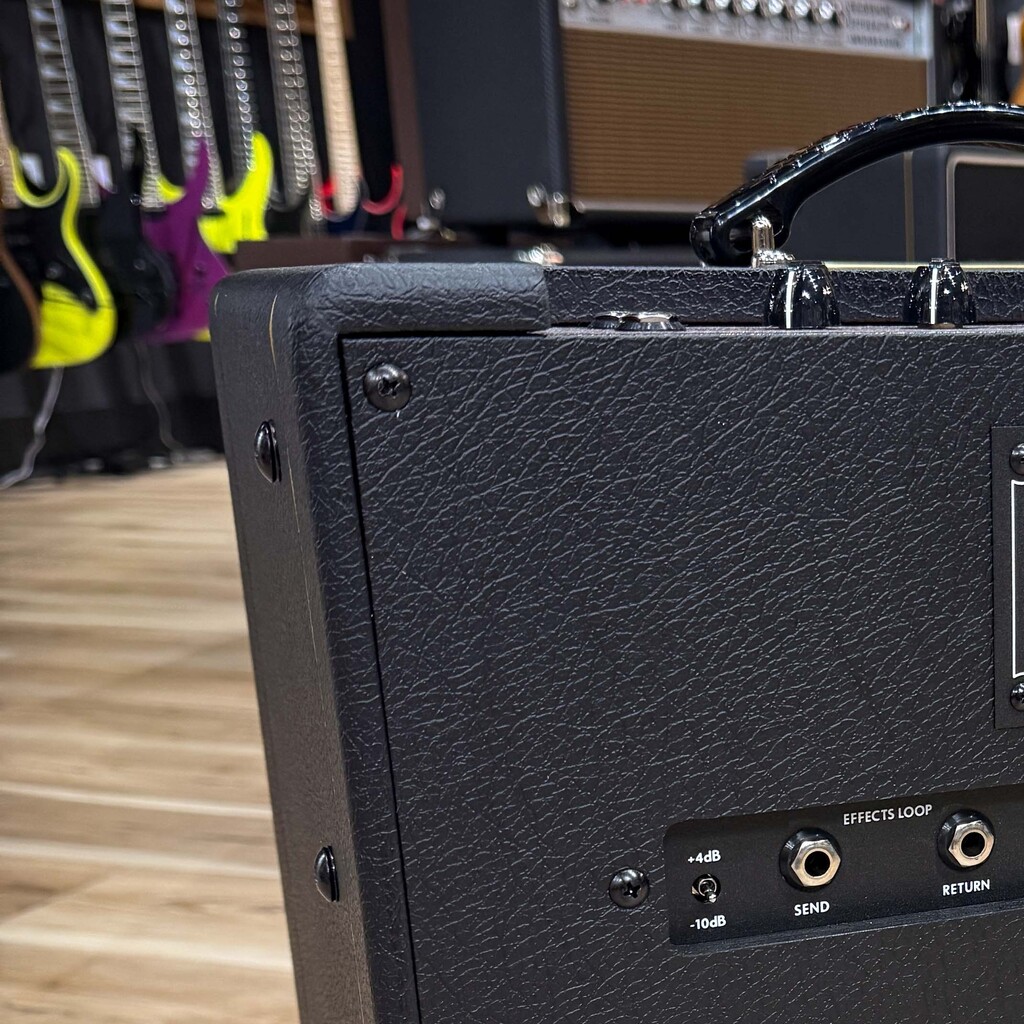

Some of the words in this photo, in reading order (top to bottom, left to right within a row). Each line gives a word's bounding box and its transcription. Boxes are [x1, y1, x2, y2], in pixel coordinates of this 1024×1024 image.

[843, 809, 895, 826] EFFECTS
[898, 804, 933, 821] LOOP
[687, 849, 721, 865] +4dB
[942, 879, 991, 896] RETURN
[794, 901, 830, 917] SEND
[689, 915, 726, 930] -10dB
